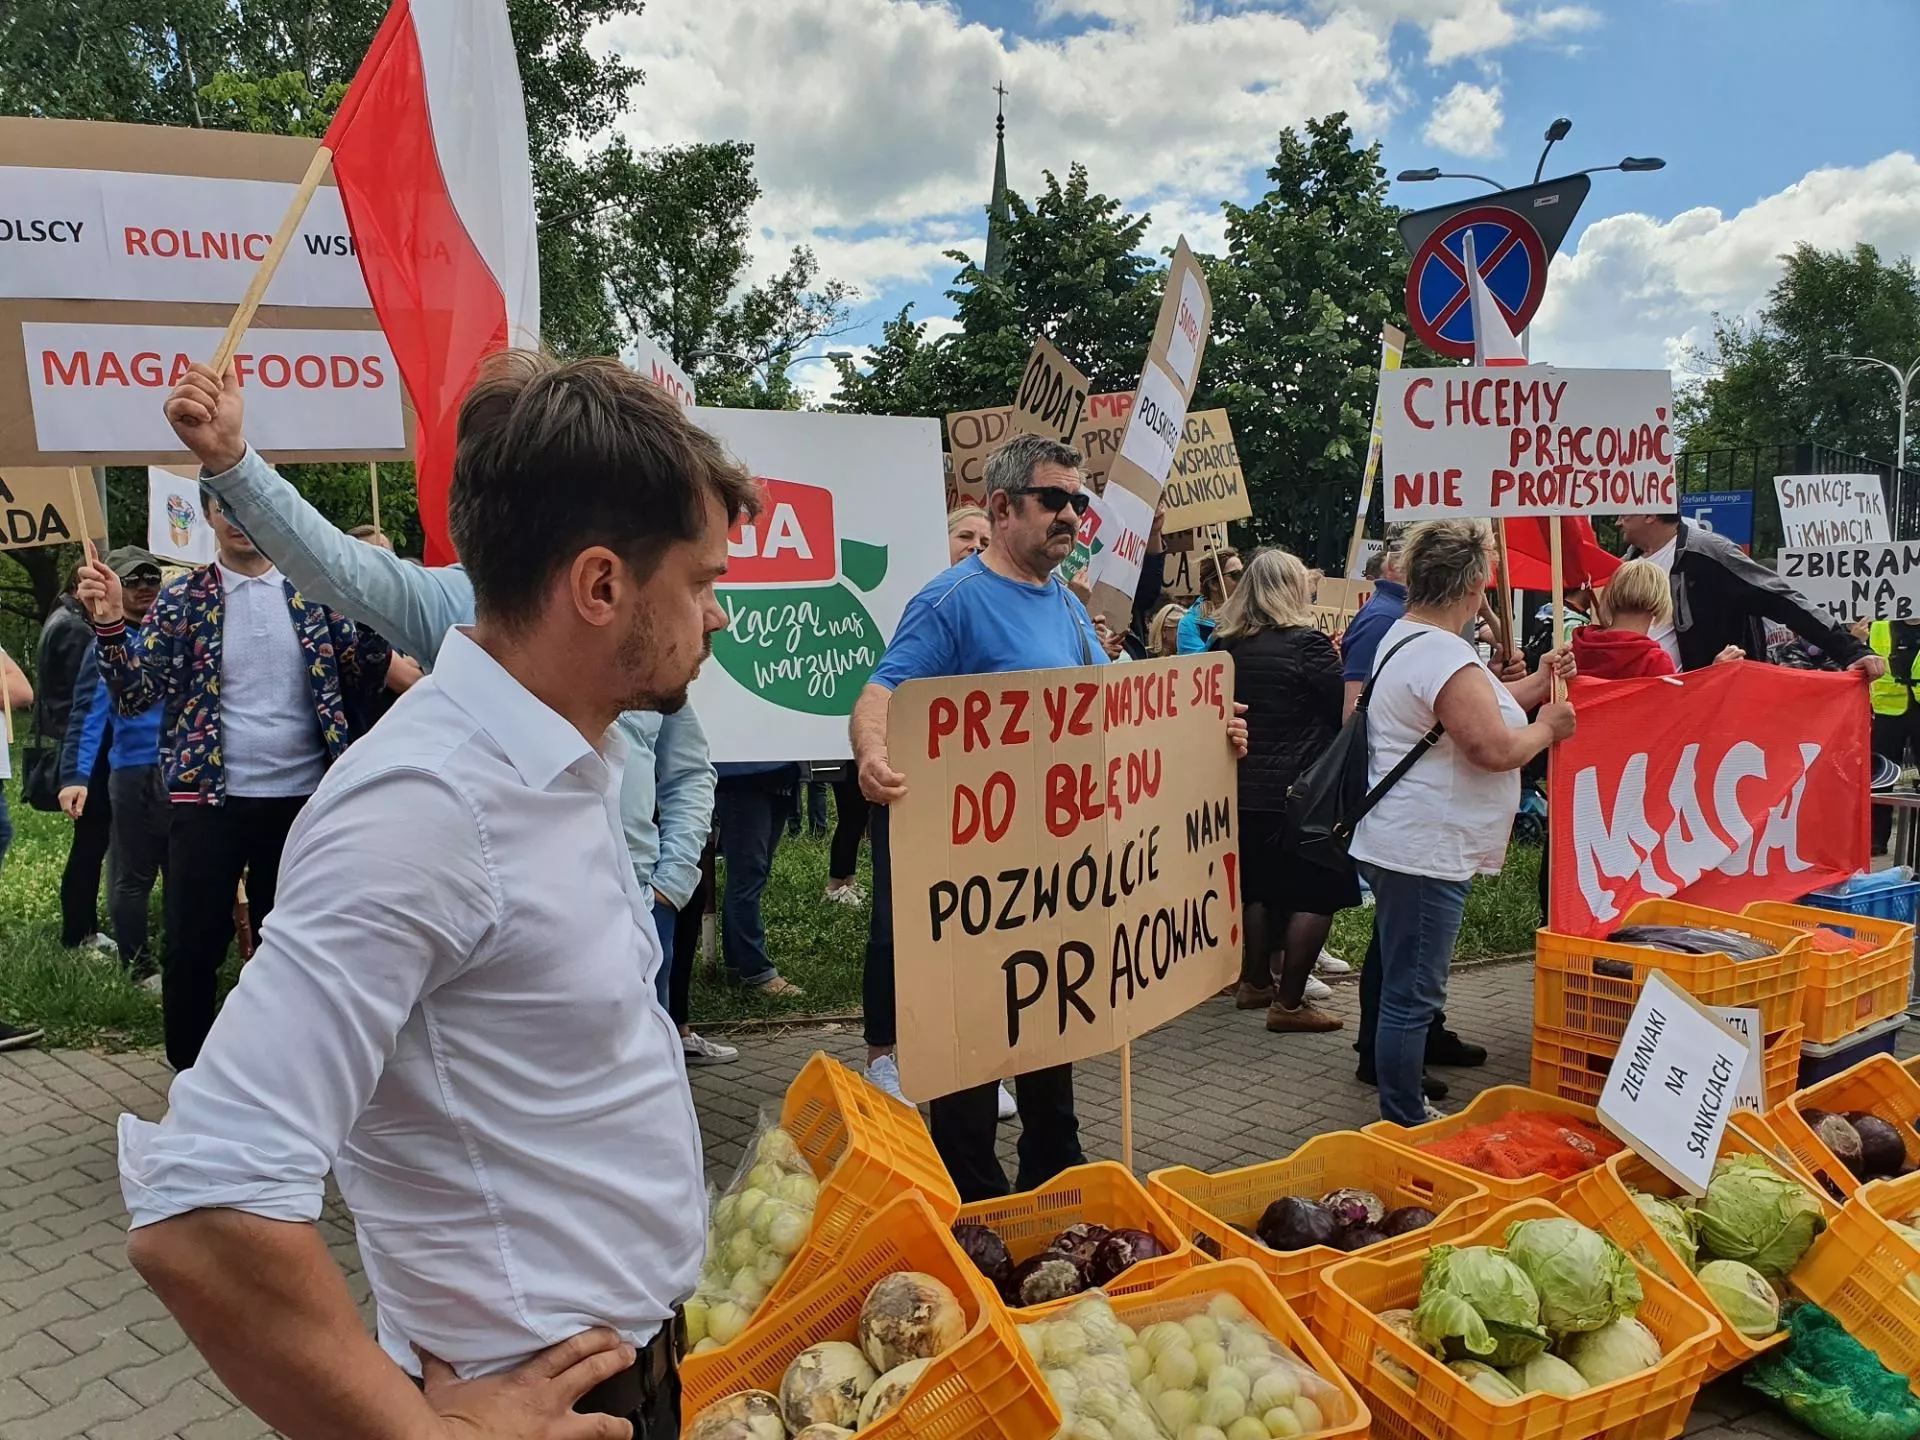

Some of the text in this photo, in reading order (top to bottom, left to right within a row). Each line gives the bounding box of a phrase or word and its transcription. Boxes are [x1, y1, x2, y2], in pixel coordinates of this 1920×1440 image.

[232, 354, 384, 388] FOODS
[1020, 352, 1085, 445] ODDAJ
[1403, 377, 1567, 429] CHCEMY
[1509, 407, 1673, 467] PRACOWAĆ
[1394, 463, 1675, 509] NIE PROTESTOWAĆ
[1710, 495, 1741, 503] Batorego
[1781, 478, 1881, 515] SANKCJE TAK
[1816, 597, 1913, 622] HLEB
[1852, 579, 1896, 601] NA
[726, 596, 863, 653] Łączą nas
[754, 646, 876, 698] warzywa
[927, 663, 1225, 759] PRZYZNAJCIE SIĘ
[951, 749, 1162, 845] DO BŁĘDU
[1186, 797, 1231, 854] NAM
[1620, 1008, 1667, 1102] ZIEMNIAKI
[1664, 1065, 1688, 1096] NA
[1687, 1053, 1733, 1159] SANKCJACH
